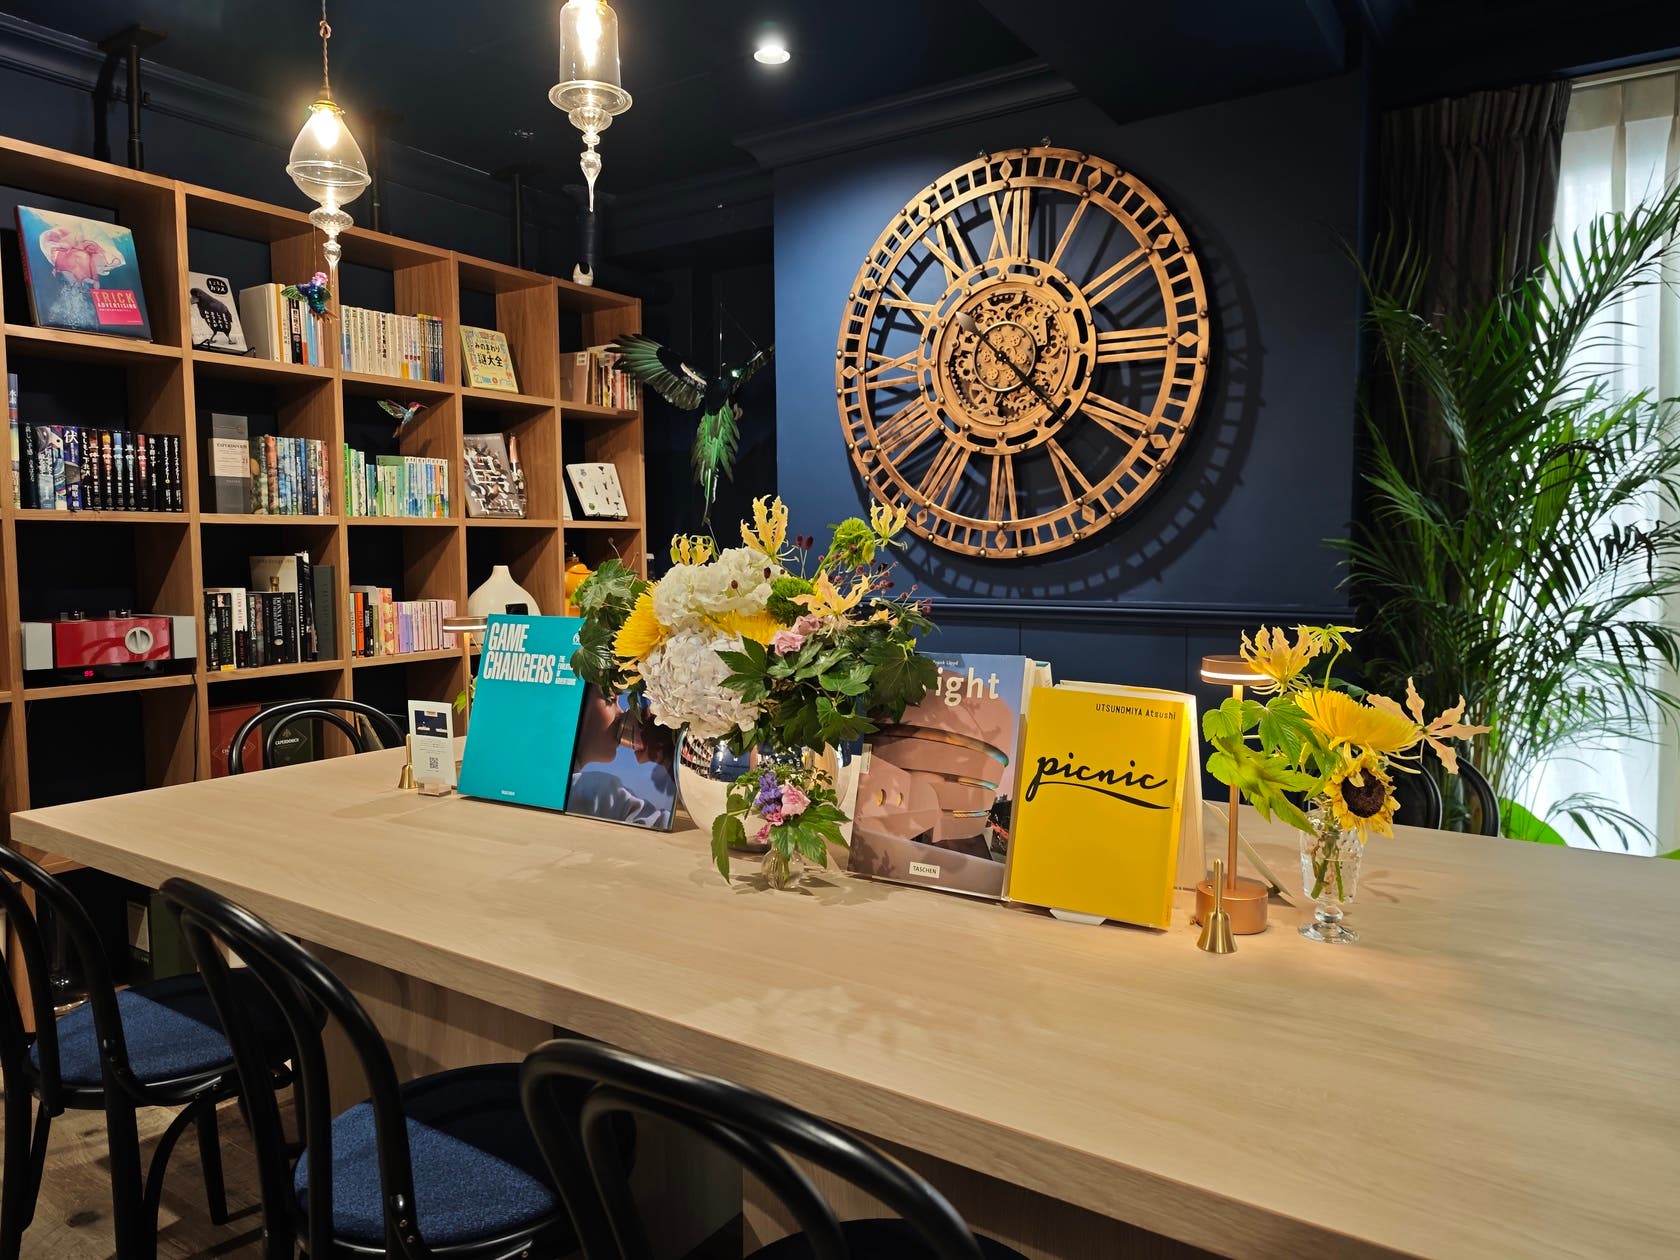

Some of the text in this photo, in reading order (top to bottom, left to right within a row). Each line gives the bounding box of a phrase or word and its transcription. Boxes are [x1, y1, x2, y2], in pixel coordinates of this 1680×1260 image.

[92, 291, 135, 304] TRICK
[1097, 327, 1168, 363] III
[64, 429, 79, 444] 伏
[488, 622, 530, 652] GAME
[483, 651, 556, 685] CHANGERS
[934, 667, 1000, 707] ight
[1095, 703, 1177, 720] UTSUNOMIYA Atsushi
[1025, 752, 1169, 802] picnic
[912, 865, 938, 875] TASCHEN
